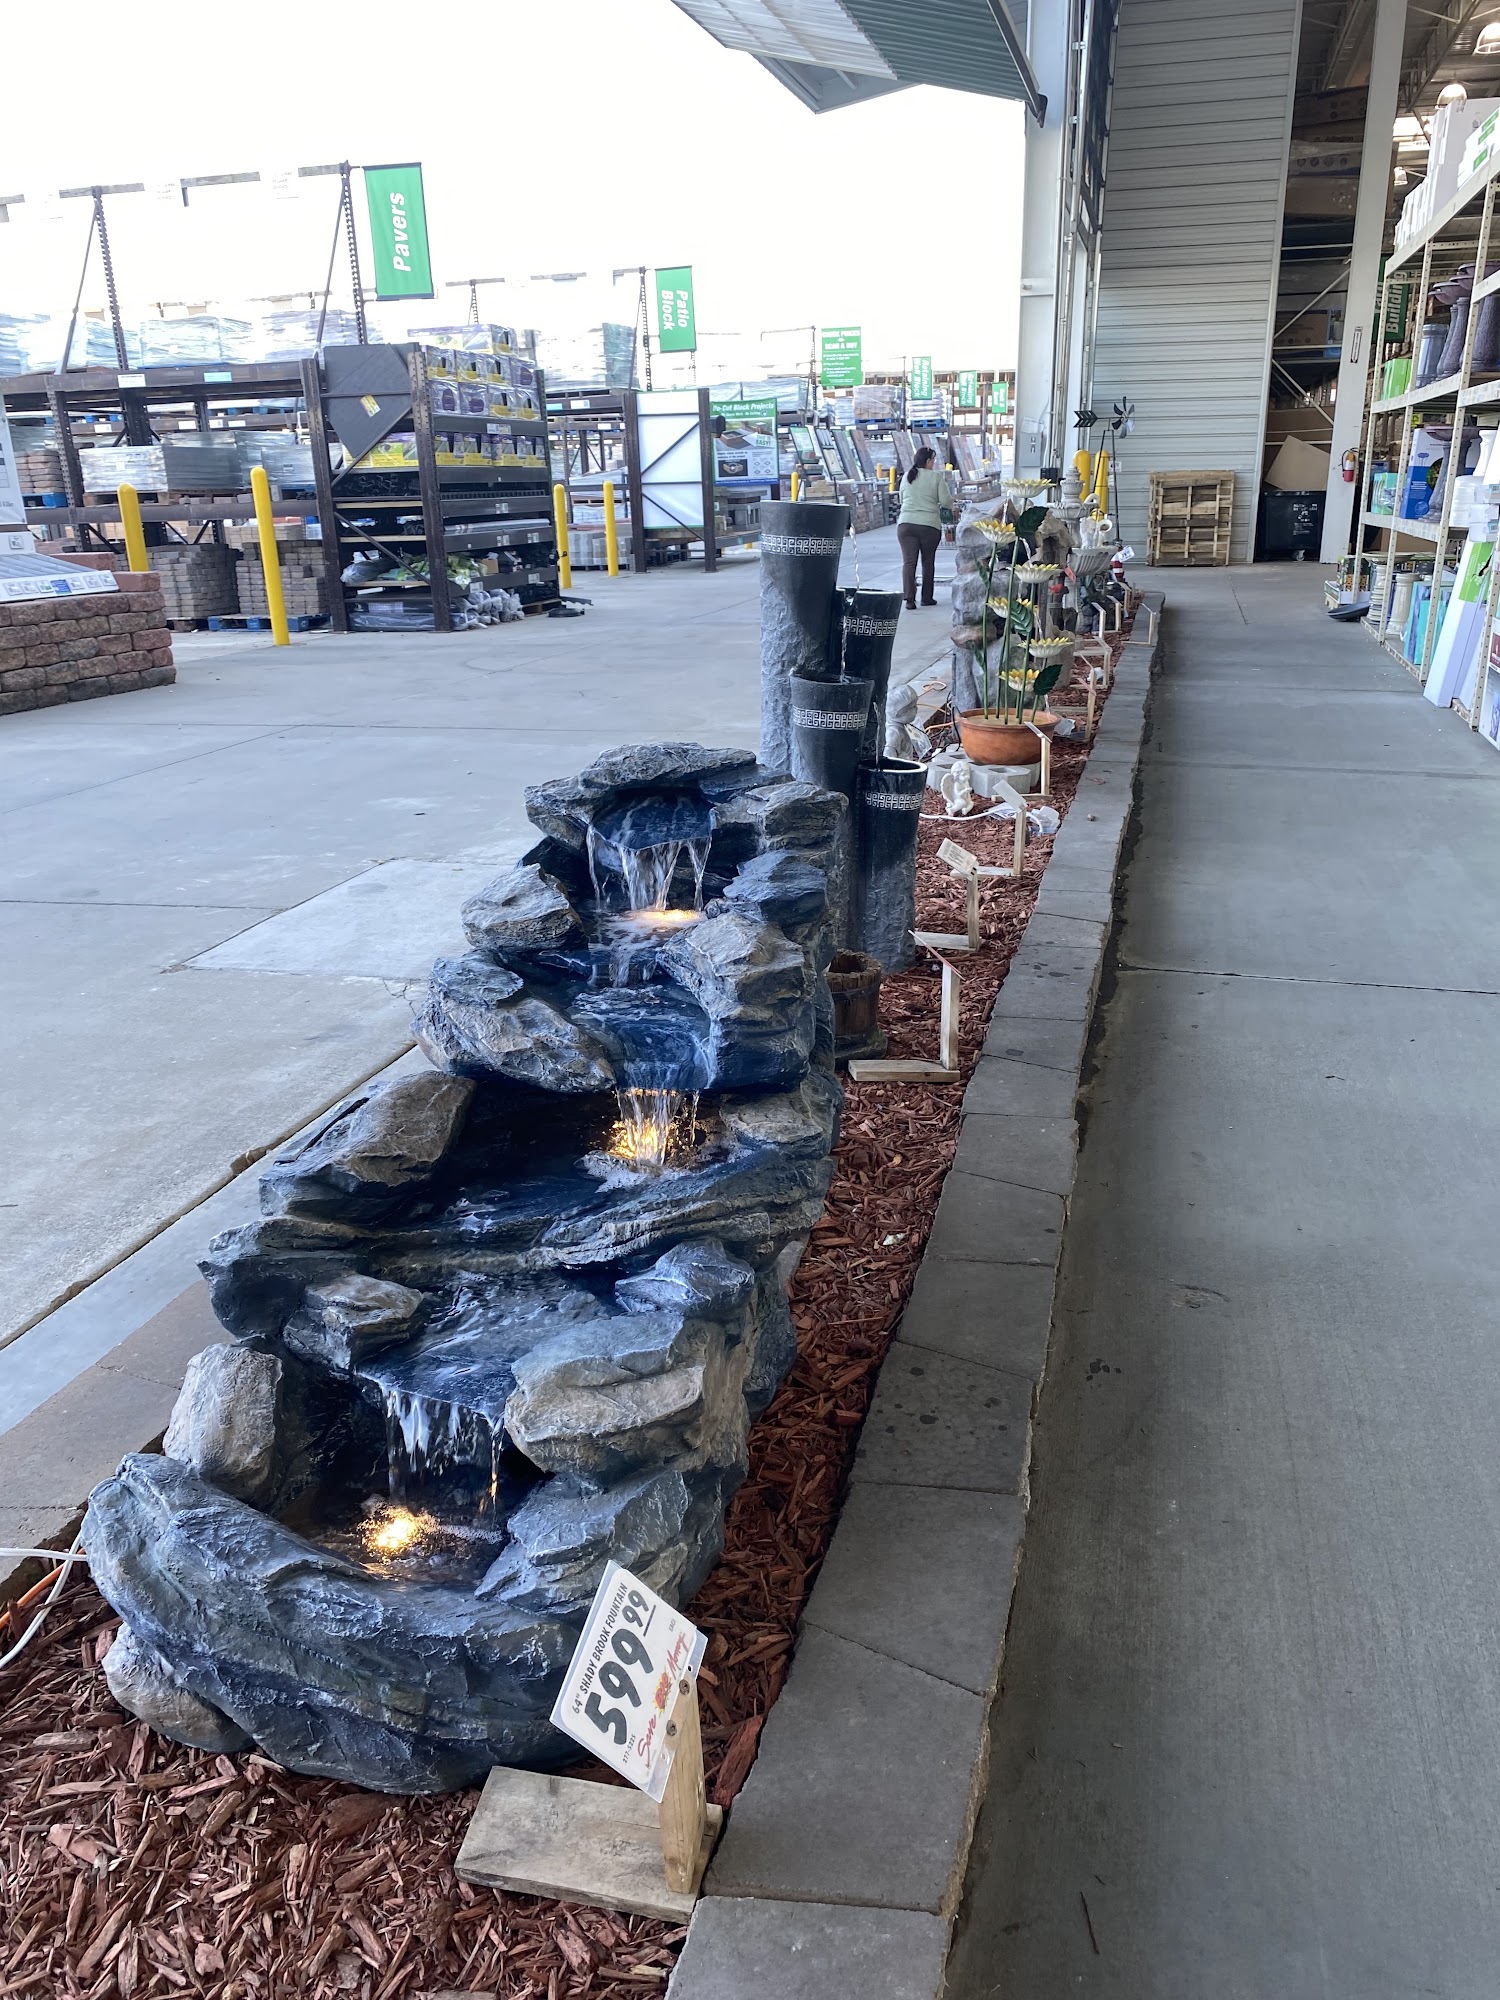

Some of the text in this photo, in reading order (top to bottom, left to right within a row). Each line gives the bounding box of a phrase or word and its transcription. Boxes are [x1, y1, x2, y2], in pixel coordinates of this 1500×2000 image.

[390, 192, 412, 272] Pavers
[661, 290, 675, 331] Block
[676, 290, 690, 328] Patio
[733, 403, 750, 411] Block
[750, 403, 775, 411] Projects
[580, 1659, 598, 1695] SHADY
[592, 1624, 611, 1662] BROOK
[605, 1583, 628, 1631] FOUNTAIN
[637, 1715, 657, 1769] Save
[667, 1632, 692, 1681] Money
